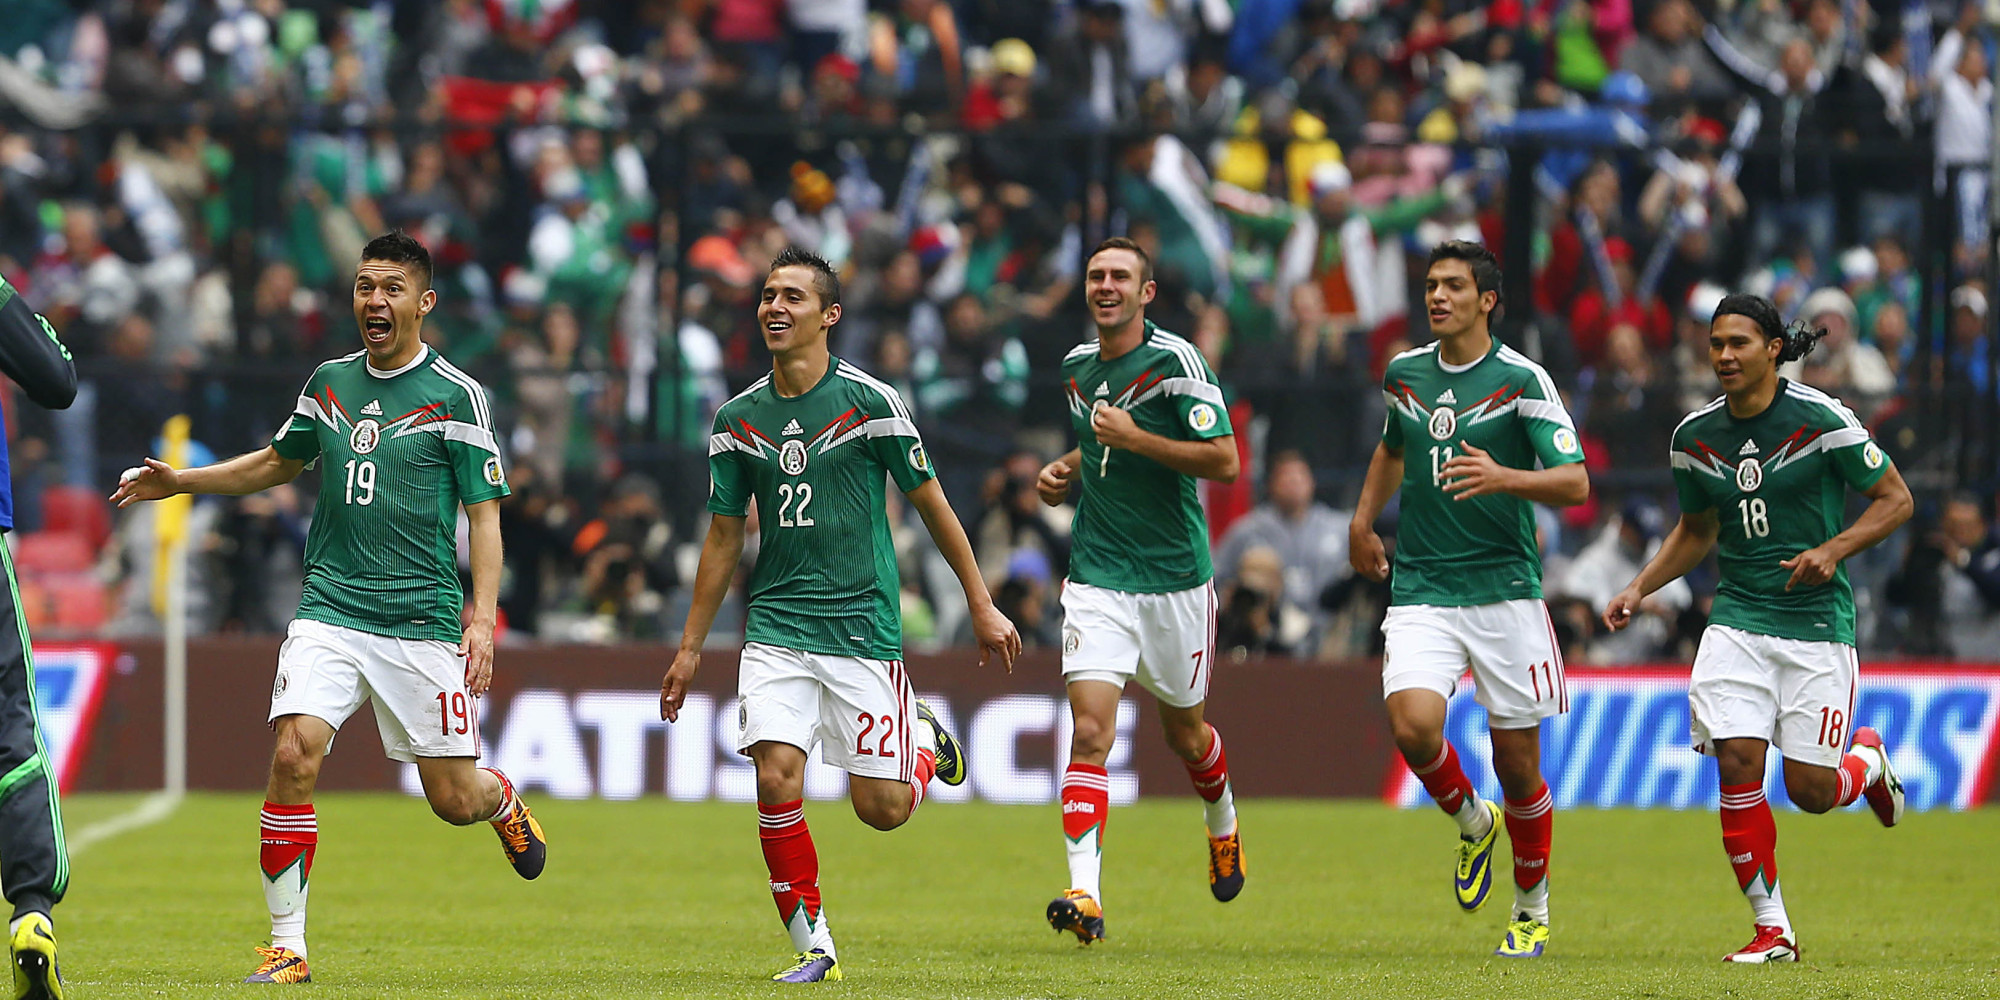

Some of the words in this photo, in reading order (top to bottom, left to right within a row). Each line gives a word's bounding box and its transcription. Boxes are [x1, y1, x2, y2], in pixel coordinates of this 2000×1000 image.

[344, 459, 376, 506] 19
[778, 482, 815, 528] 22
[1738, 497, 1770, 540] 18
[1189, 649, 1203, 690] 7
[1528, 660, 1554, 702] 11
[436, 691, 468, 736] 19
[857, 711, 895, 758] 22
[1817, 706, 1844, 748] 18
